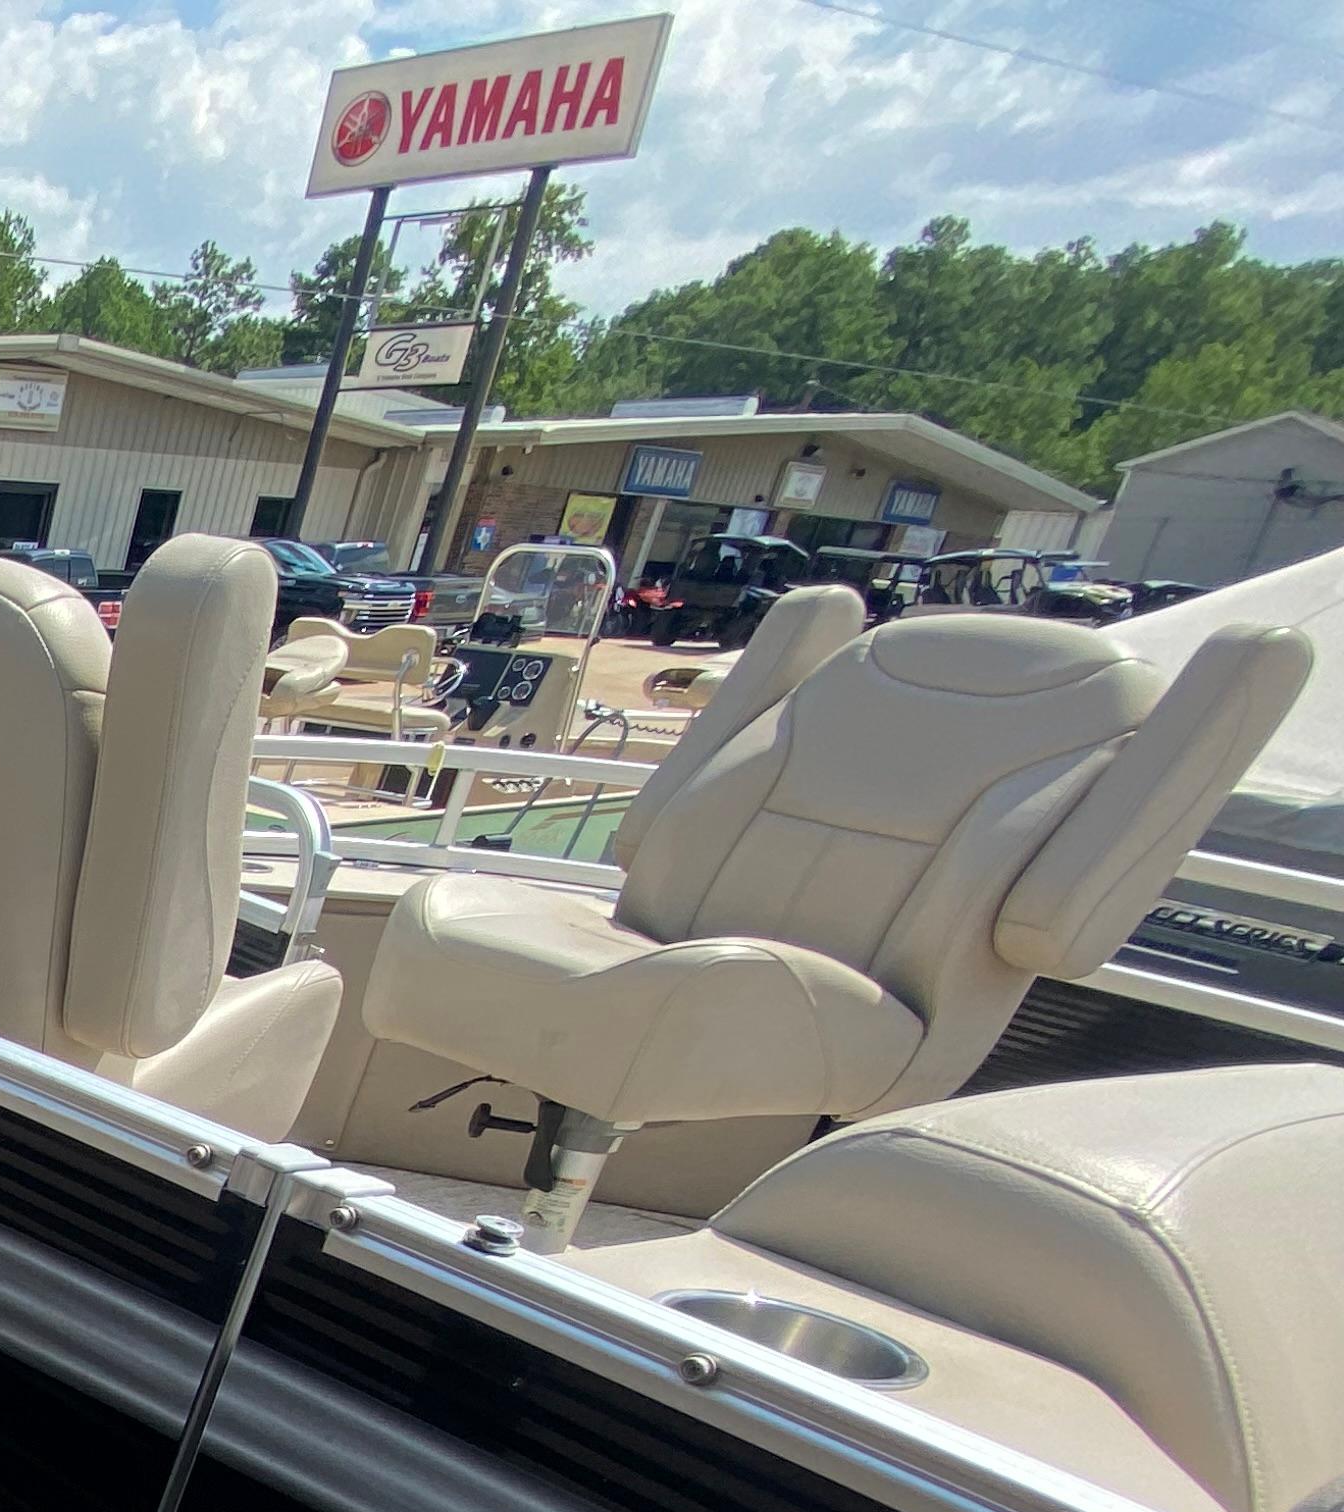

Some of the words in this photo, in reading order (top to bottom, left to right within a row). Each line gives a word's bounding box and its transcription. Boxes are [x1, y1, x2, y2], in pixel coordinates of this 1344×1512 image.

[398, 56, 625, 154] YAMAHA
[375, 333, 429, 372] G3
[635, 456, 696, 489] YAMAHA
